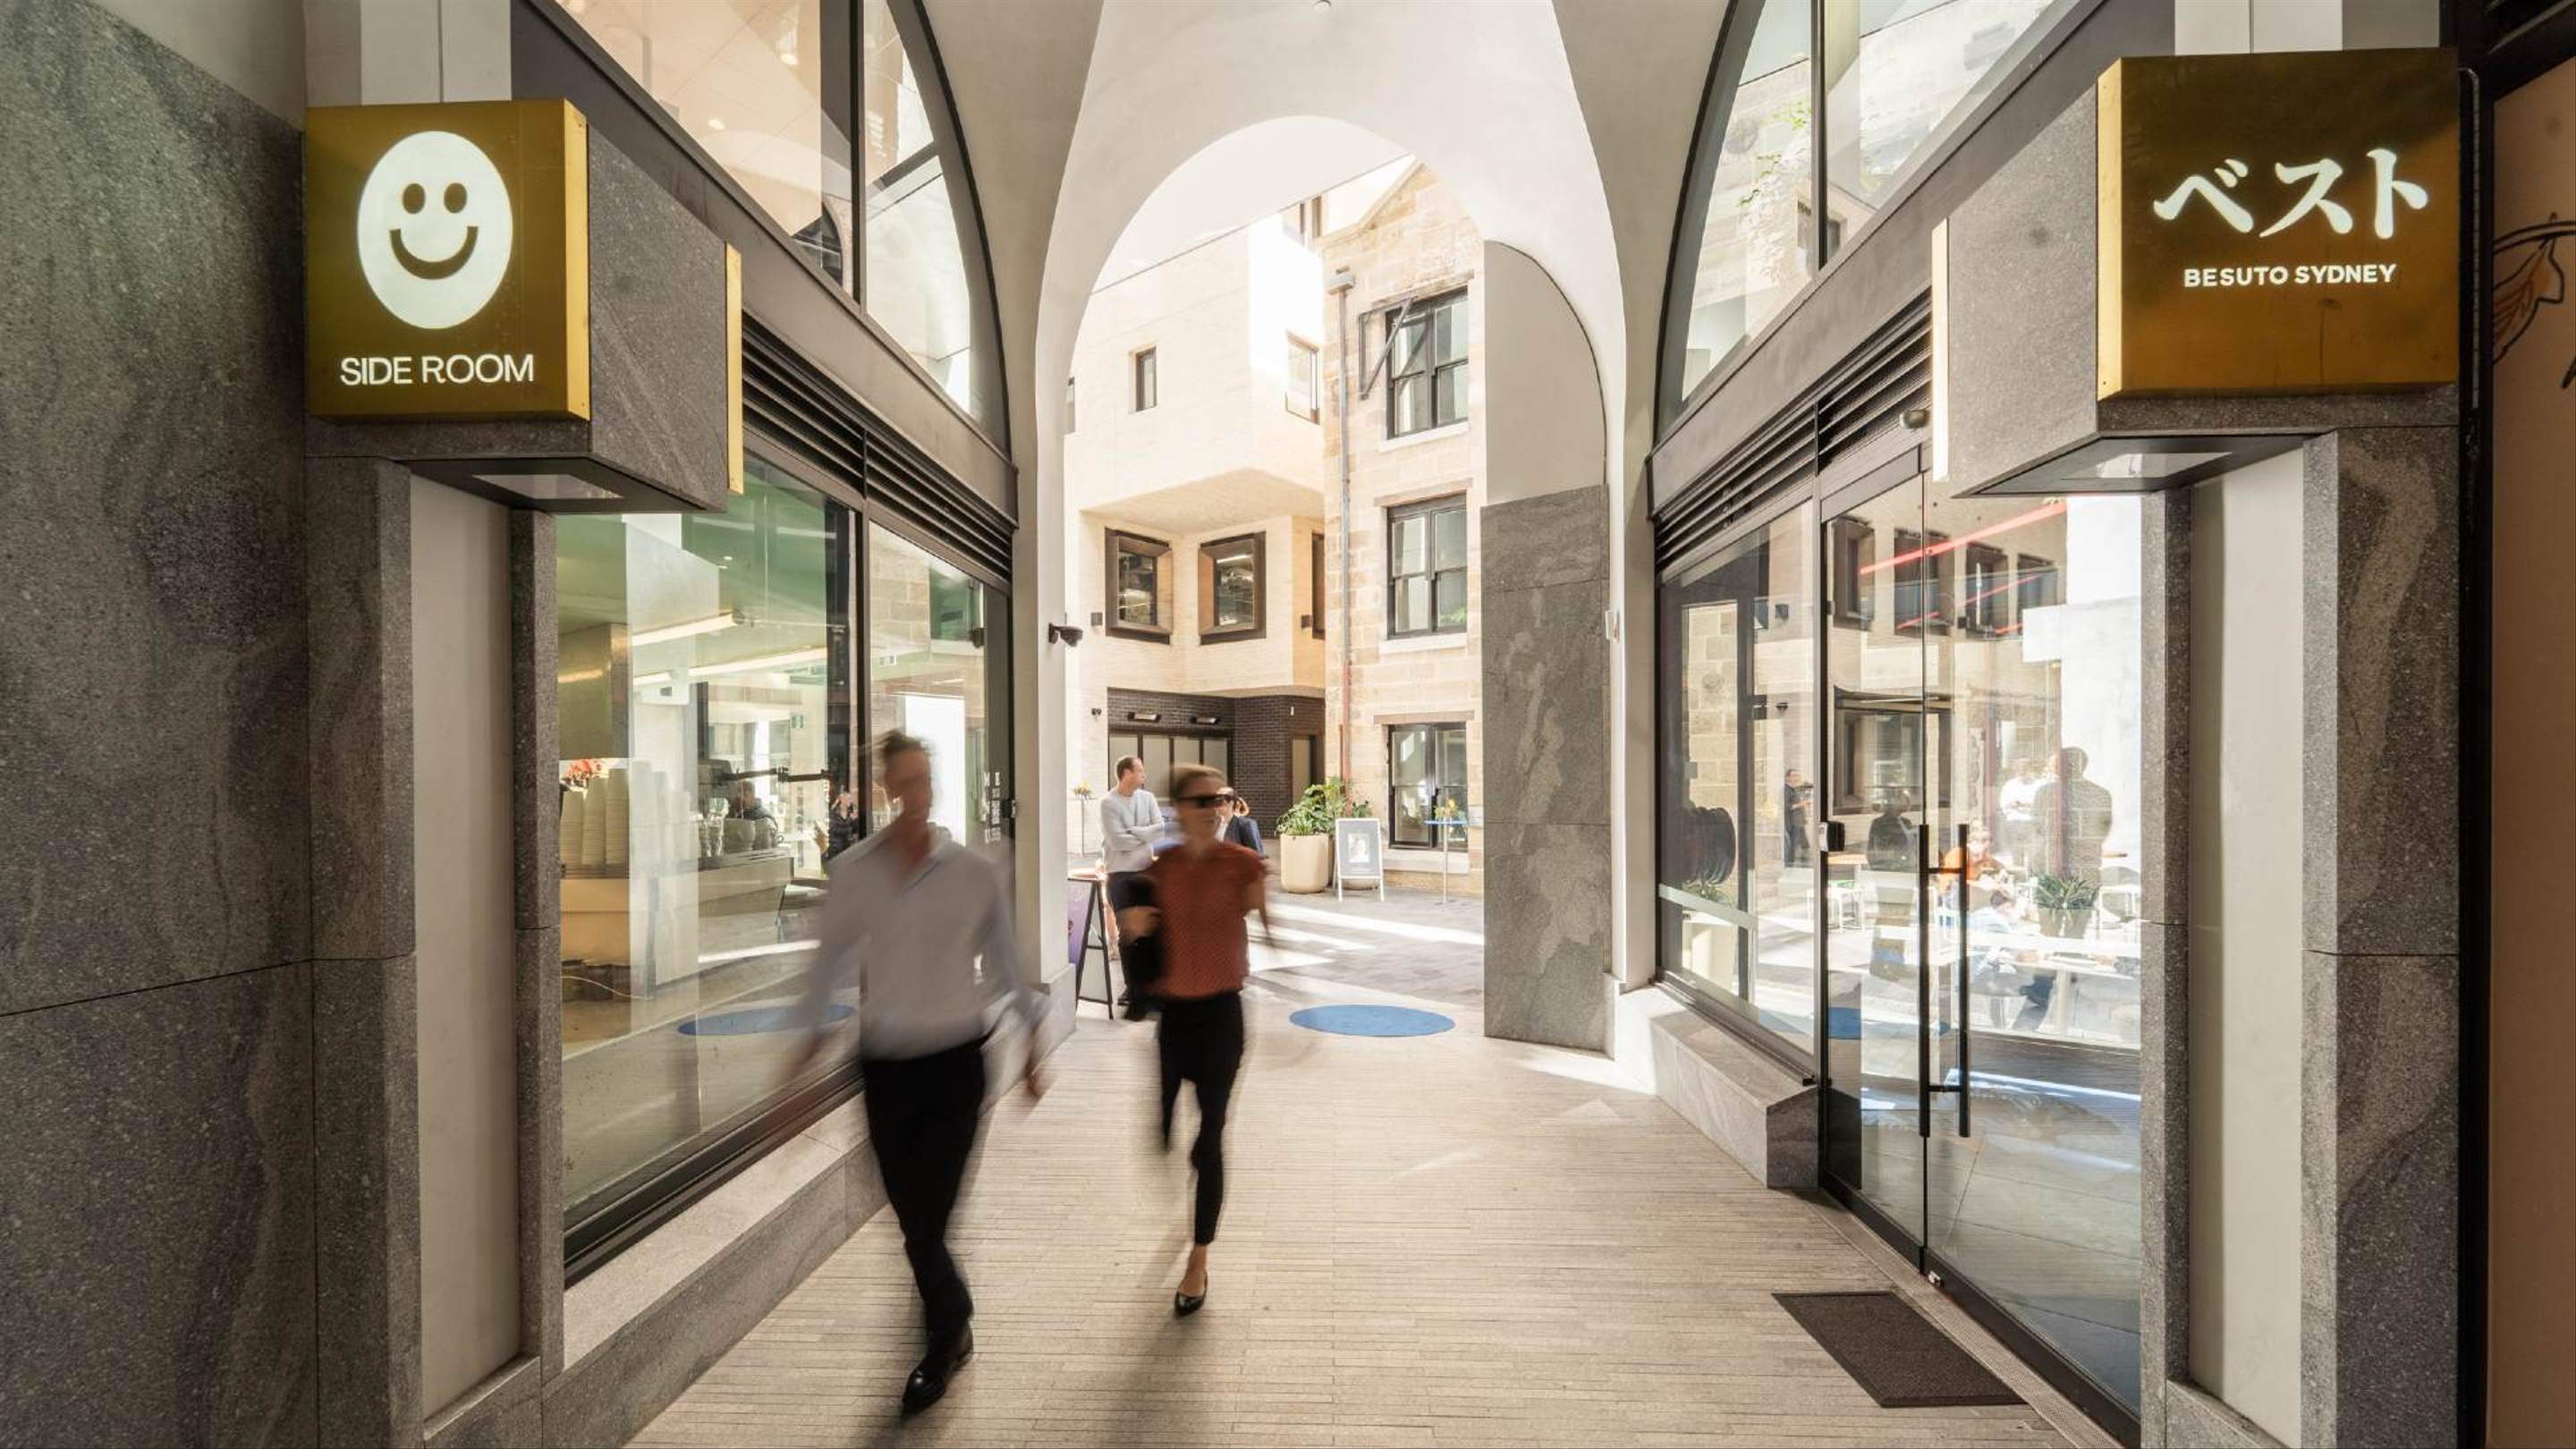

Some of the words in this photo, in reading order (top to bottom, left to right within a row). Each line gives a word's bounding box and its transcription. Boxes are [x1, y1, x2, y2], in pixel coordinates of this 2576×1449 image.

[2153, 148, 2429, 240] ベスト
[2183, 266, 2289, 288] BESUTO
[2294, 263, 2397, 284] SYDNEY
[340, 356, 413, 386] SIDE
[421, 353, 534, 384] ROOM
